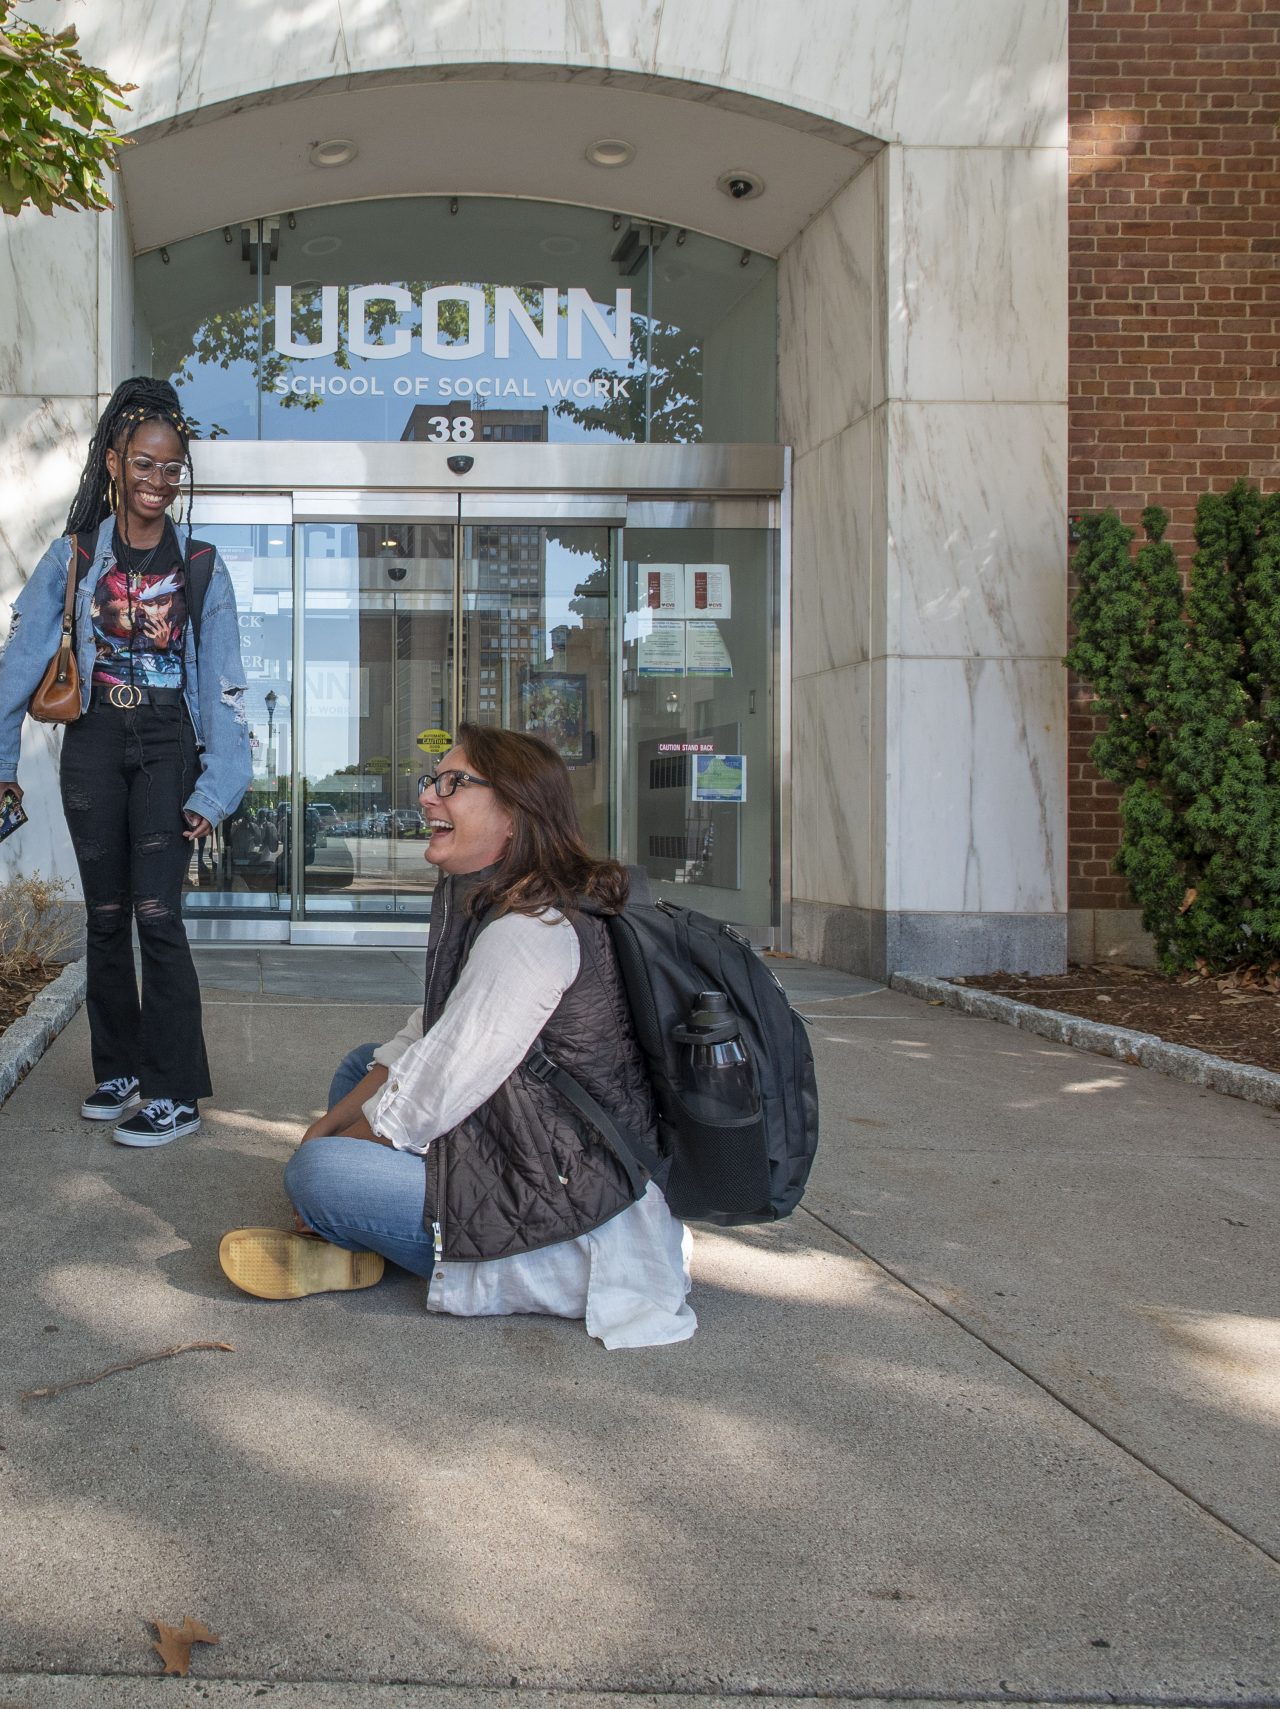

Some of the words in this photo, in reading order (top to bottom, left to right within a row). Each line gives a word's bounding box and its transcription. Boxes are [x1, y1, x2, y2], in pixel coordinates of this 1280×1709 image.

[274, 284, 632, 360] UCONN
[274, 375, 384, 396] SCHOOL
[393, 376, 430, 396] OF
[438, 376, 536, 397] SOCIAL
[545, 378, 631, 398] WORK
[427, 416, 475, 443] 38
